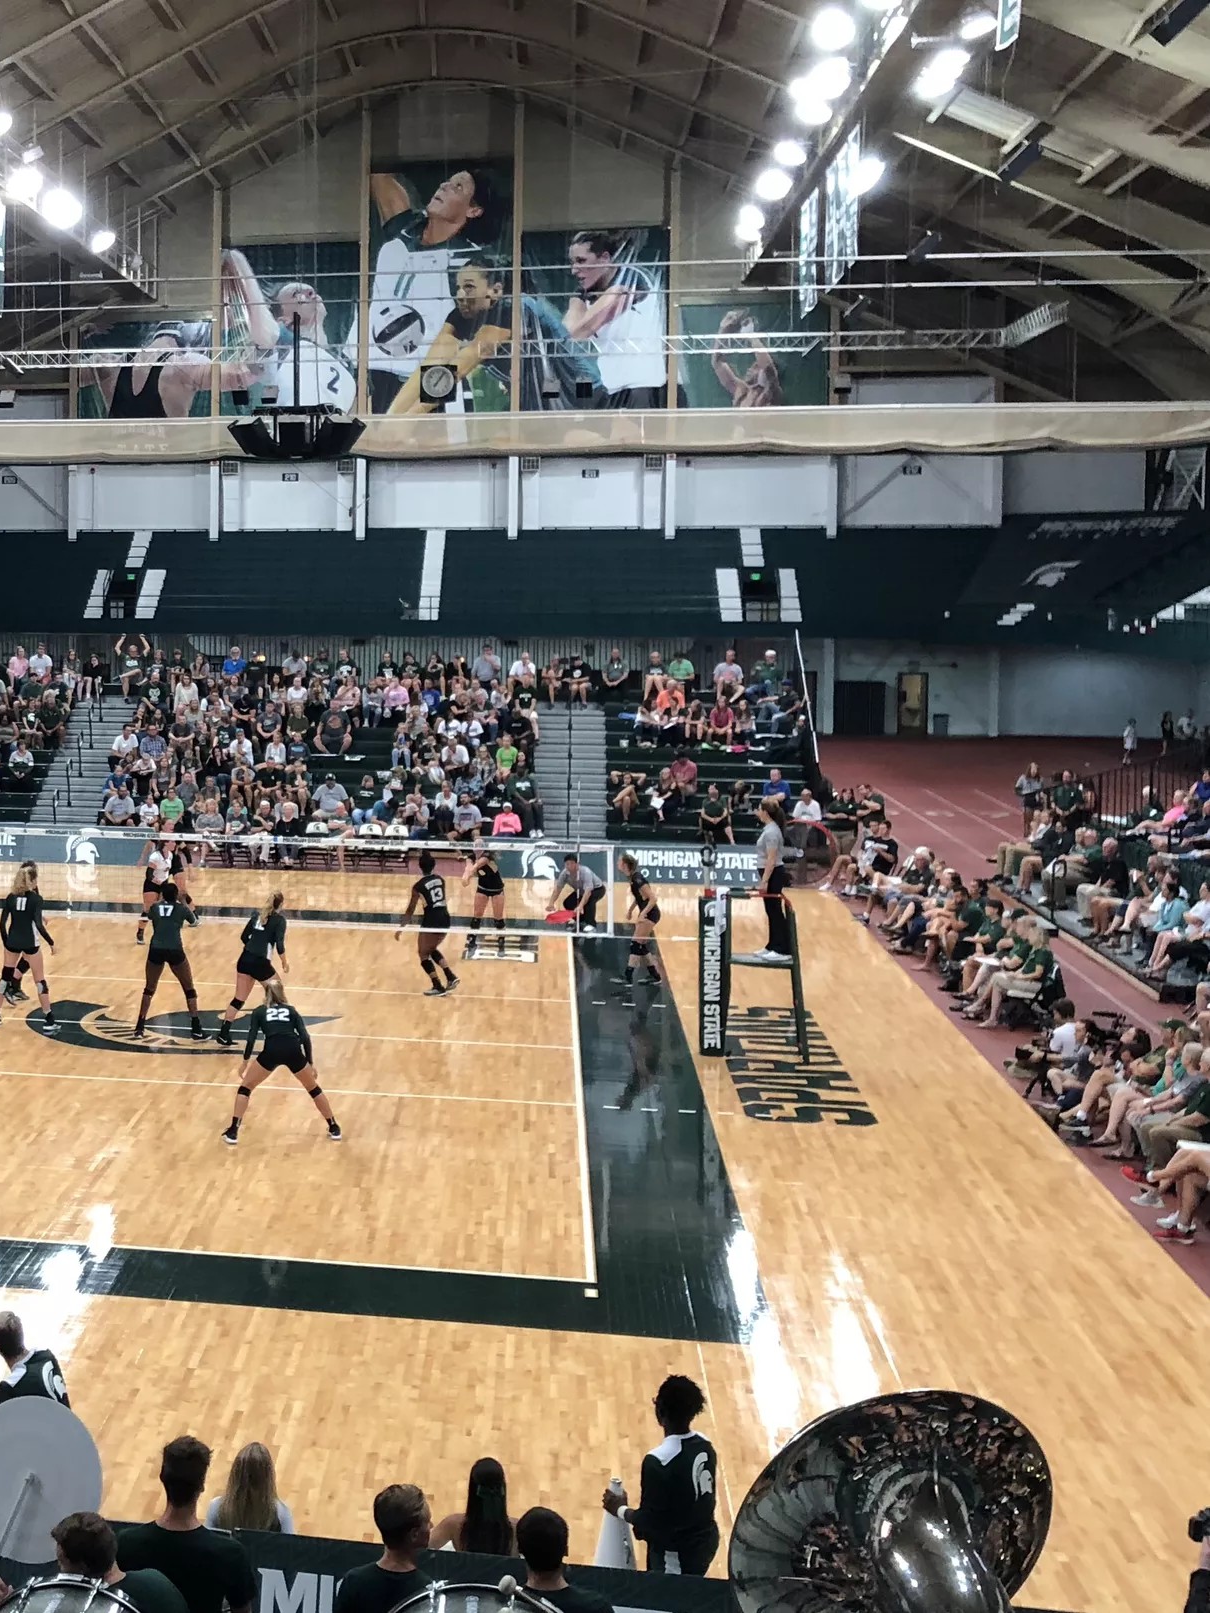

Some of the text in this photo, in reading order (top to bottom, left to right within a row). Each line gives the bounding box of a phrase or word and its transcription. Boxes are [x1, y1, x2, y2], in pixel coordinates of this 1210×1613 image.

[327, 366, 341, 395] 2
[715, 853, 759, 870] STATE
[640, 868, 759, 882] OLLEYBALL
[430, 887, 443, 903] 13
[16, 897, 27, 911] 11
[158, 904, 174, 917] 17
[704, 924, 722, 1050] MICHIGAN STATE
[266, 1008, 290, 1021] 22
